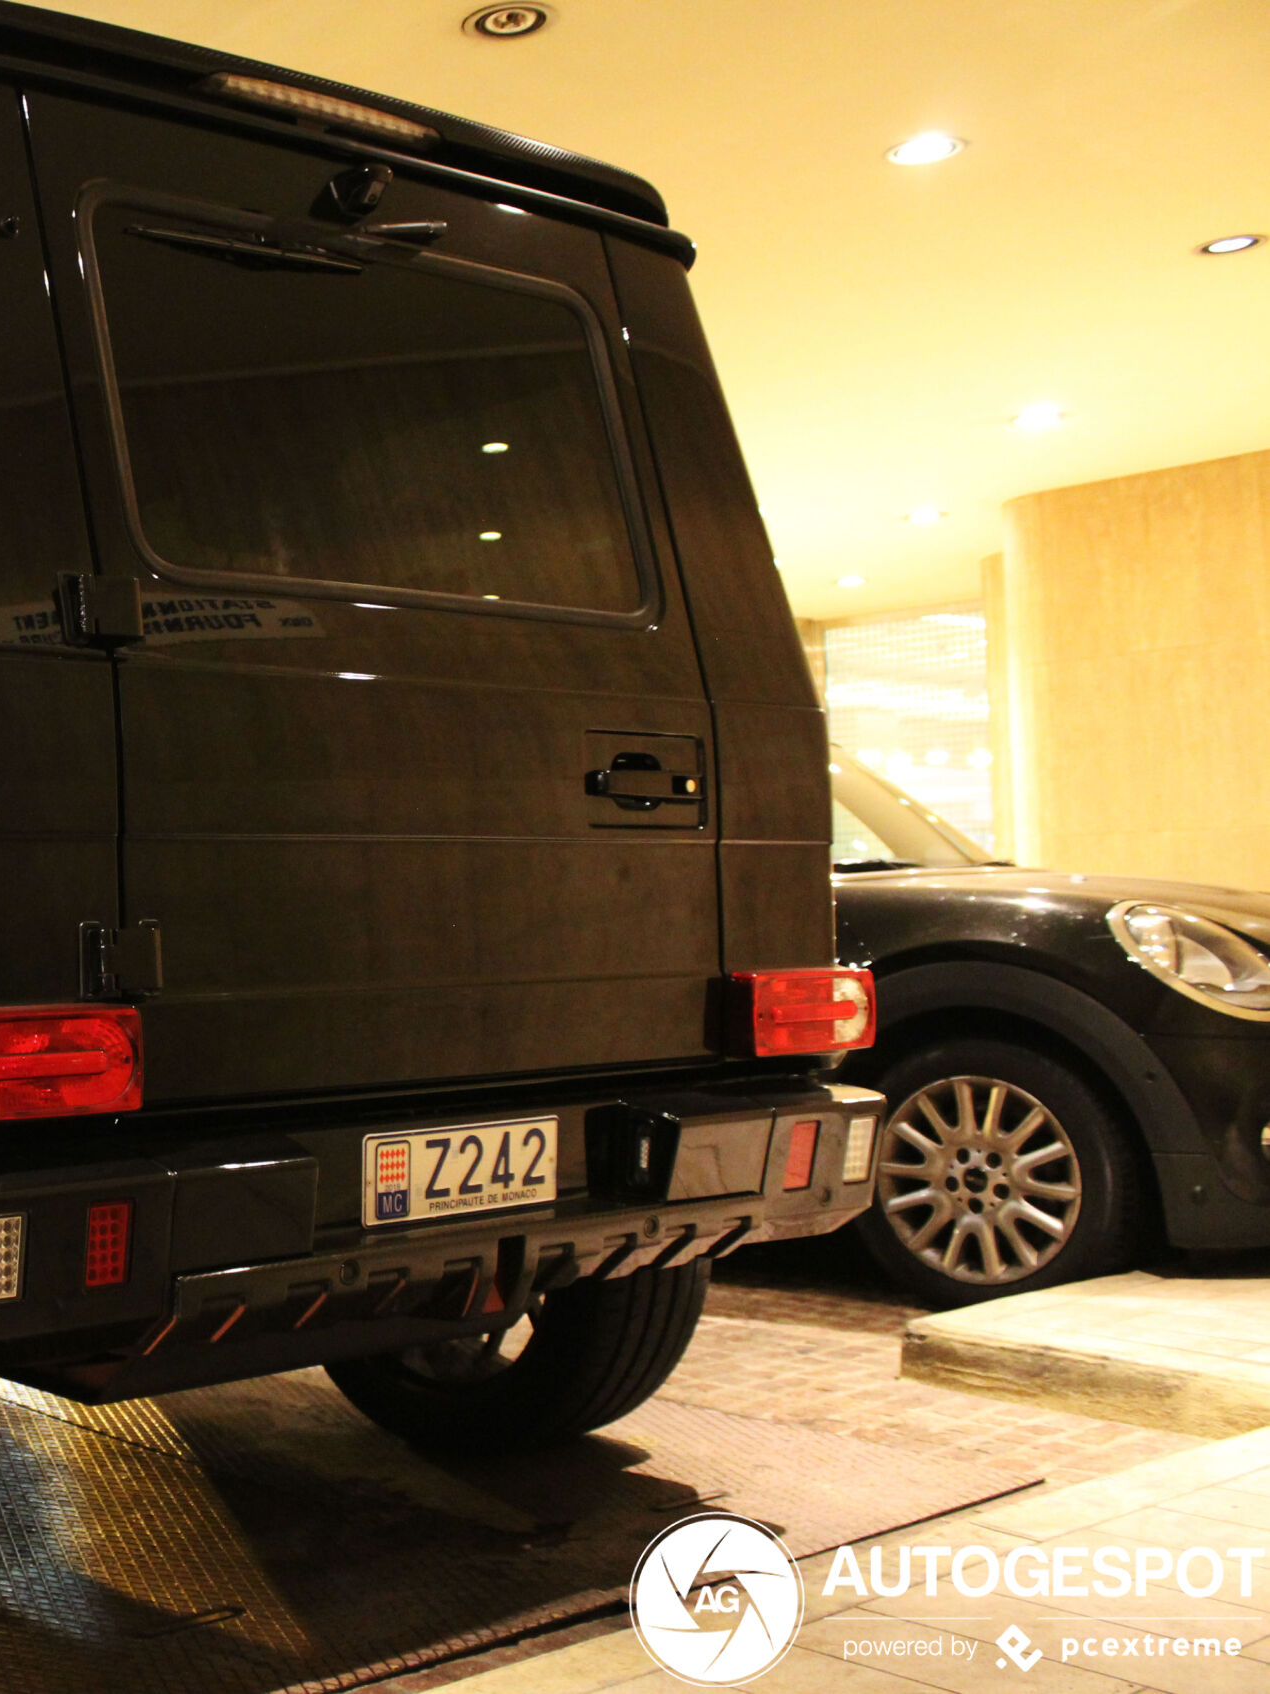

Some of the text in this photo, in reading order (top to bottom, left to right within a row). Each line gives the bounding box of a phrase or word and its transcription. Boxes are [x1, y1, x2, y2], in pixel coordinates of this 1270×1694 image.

[425, 1127, 546, 1200] Z242
[382, 1193, 403, 1213] MC
[429, 1188, 537, 1212] PRINCIPAUTE DE MONACO
